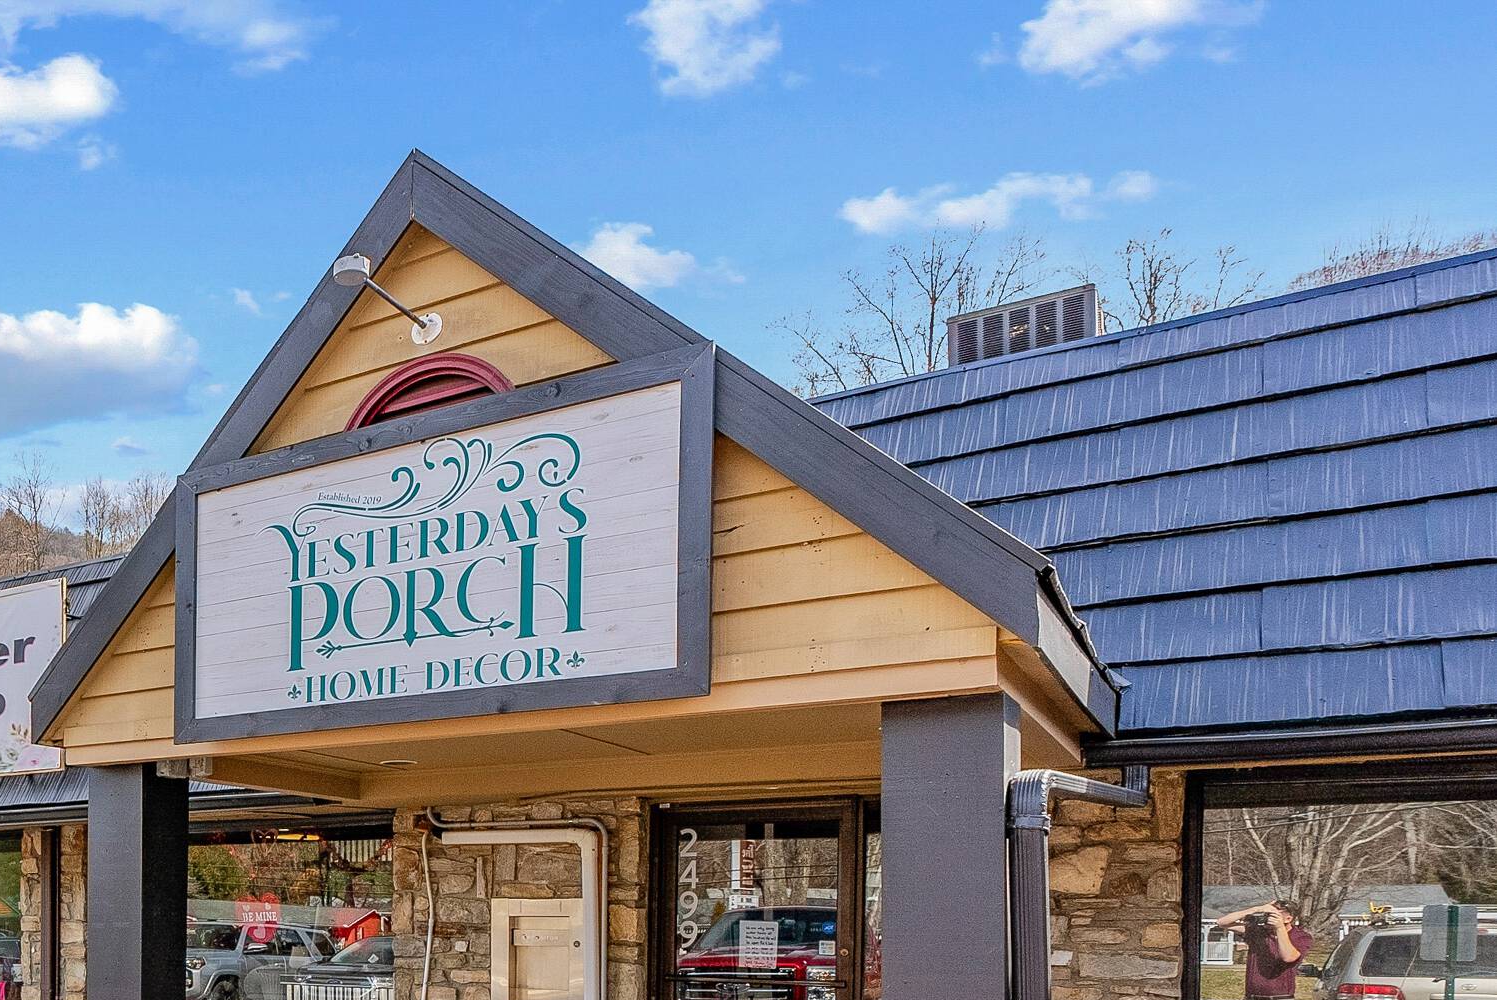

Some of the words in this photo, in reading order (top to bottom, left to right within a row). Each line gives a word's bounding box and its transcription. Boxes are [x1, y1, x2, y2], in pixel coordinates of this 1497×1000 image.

[317, 492, 361, 504] Established
[362, 495, 382, 505] 2019
[287, 534, 587, 672] PORCH
[305, 665, 409, 703] HOME
[424, 647, 563, 691] DECOR
[242, 911, 254, 922] BE
[255, 911, 278, 922] MINE
[678, 828, 699, 949] 2499
